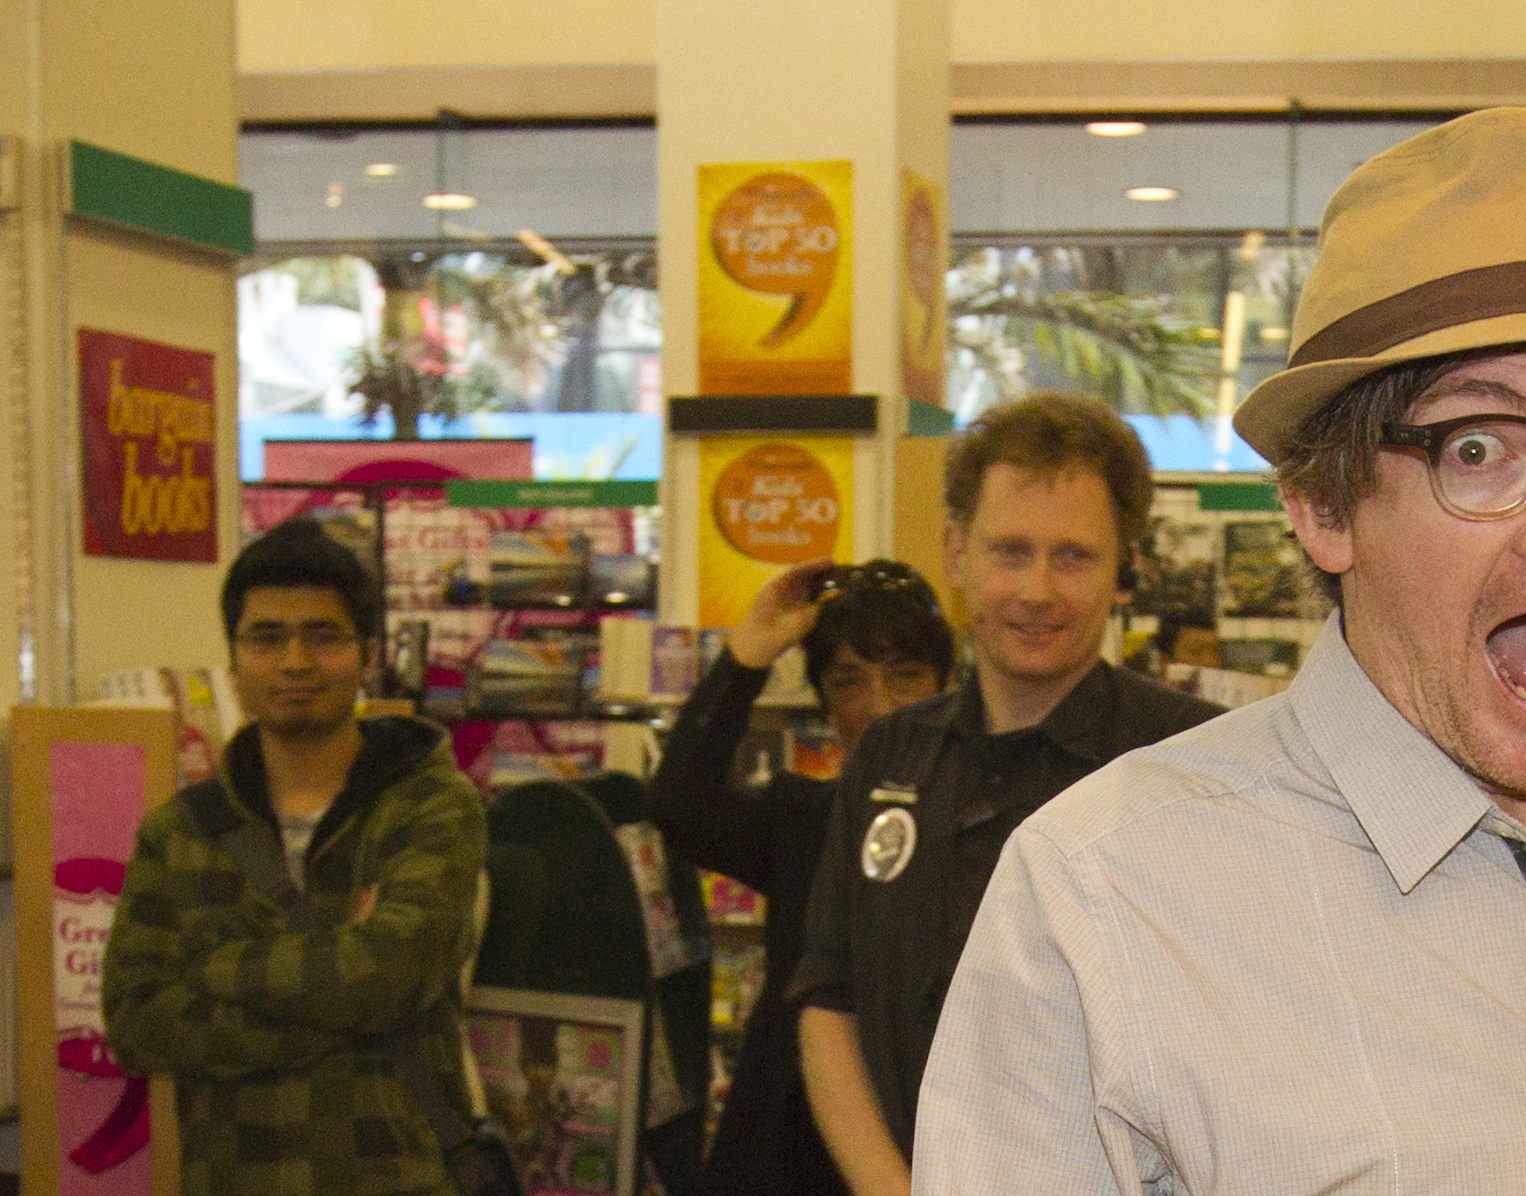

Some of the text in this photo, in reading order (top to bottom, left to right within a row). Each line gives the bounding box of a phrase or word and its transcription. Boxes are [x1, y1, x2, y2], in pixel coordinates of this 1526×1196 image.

[721, 227, 789, 254] TOP
[122, 441, 210, 536] books
[722, 498, 790, 523] TOP
